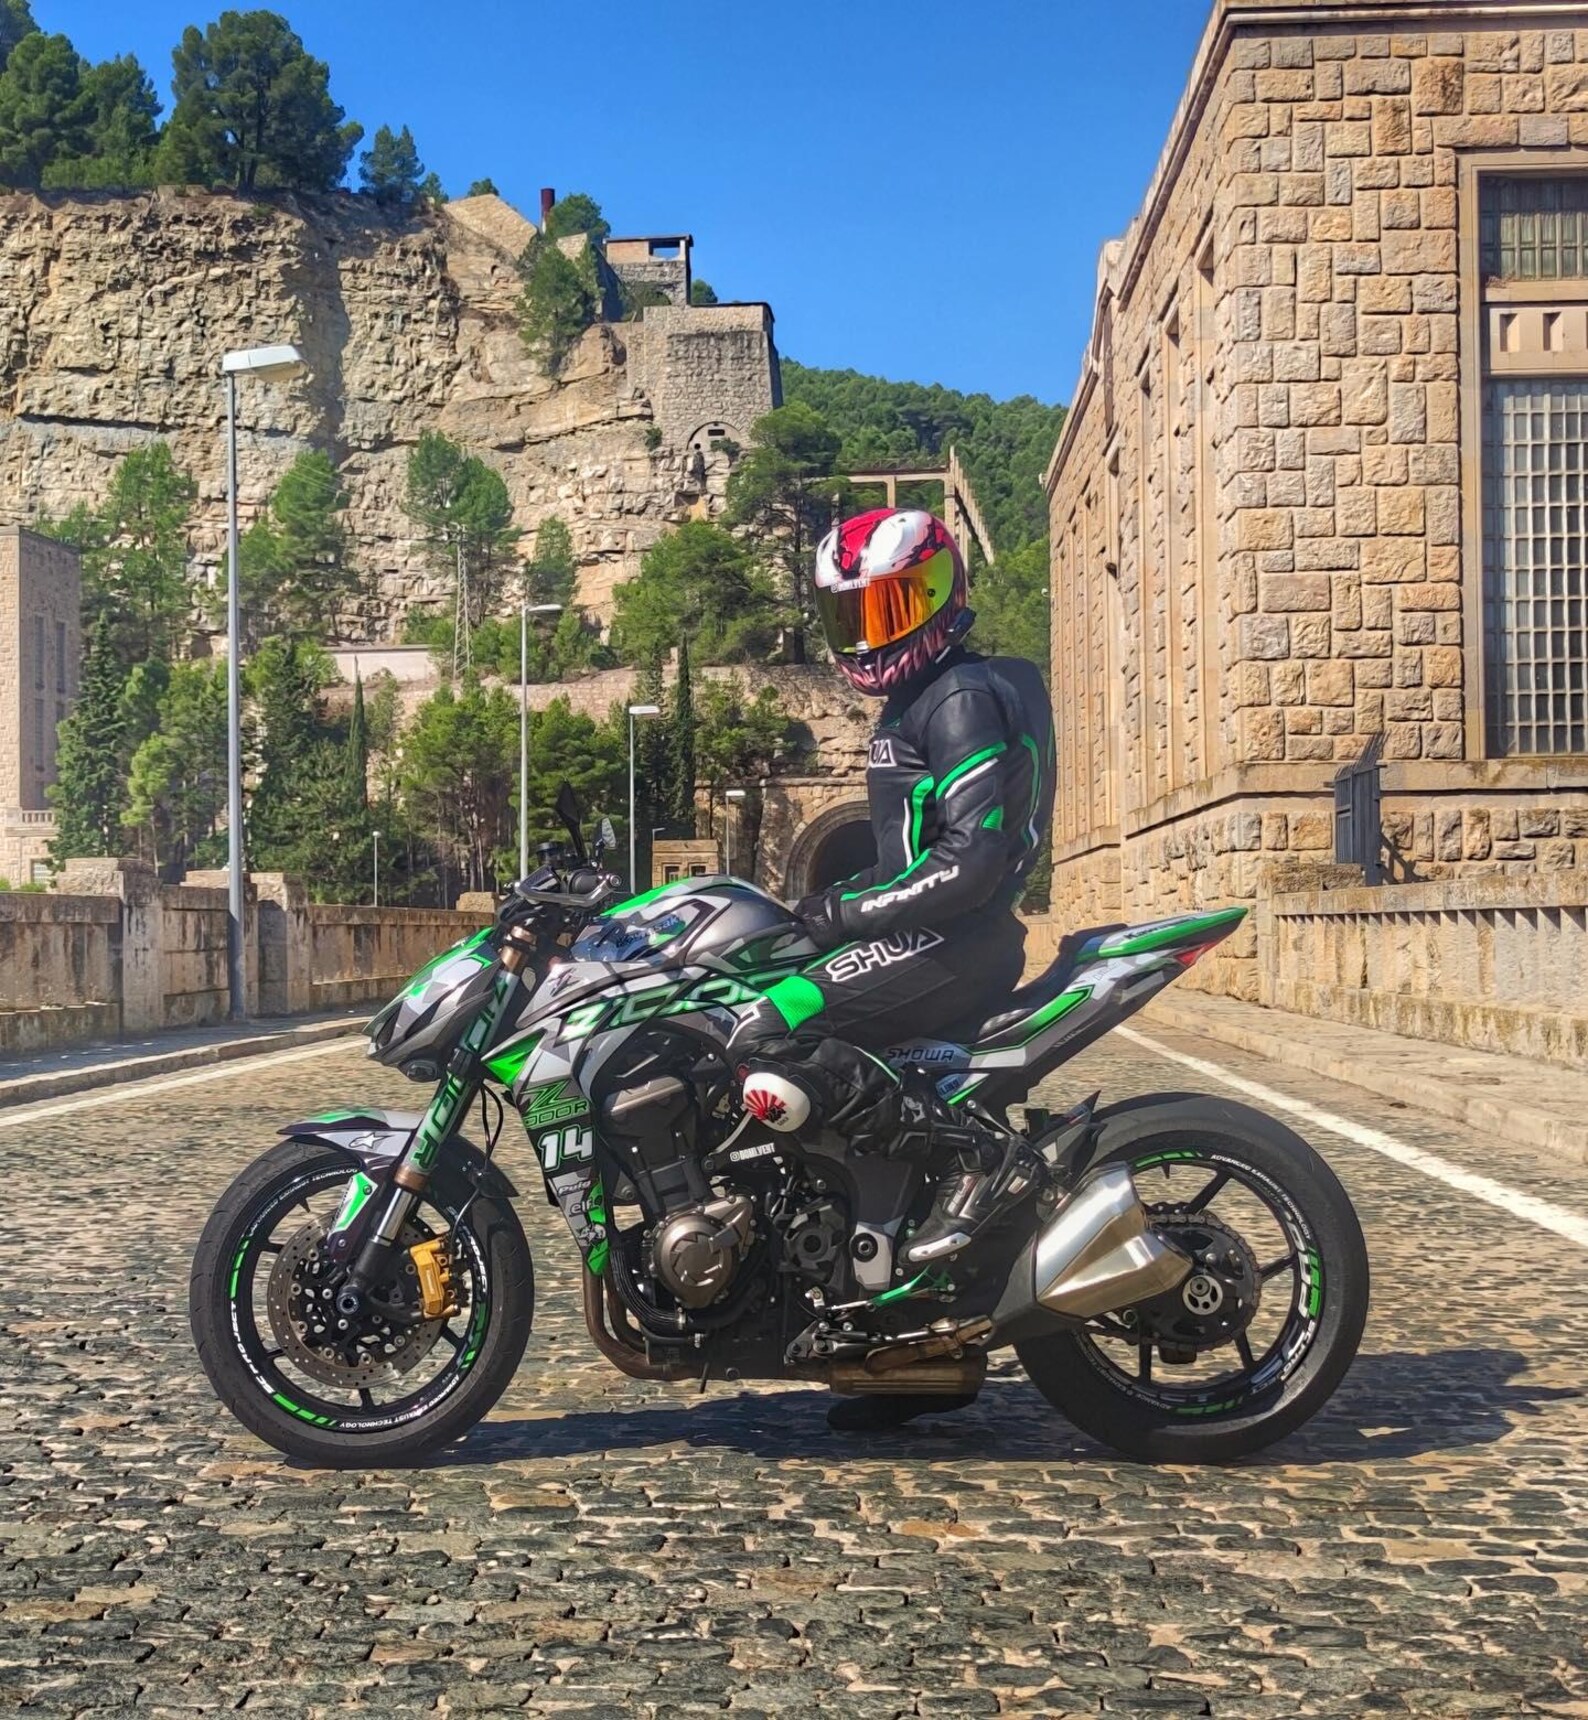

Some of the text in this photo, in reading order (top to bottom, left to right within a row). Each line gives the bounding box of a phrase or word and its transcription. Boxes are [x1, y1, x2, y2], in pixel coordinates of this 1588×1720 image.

[825, 927, 944, 981] SHUA
[887, 1047, 955, 1061] SHOWA
[539, 1126, 595, 1171] 14
[1279, 1191, 1311, 1241] TECHNOLOGY
[338, 1417, 393, 1429] TECHNOLOGY
